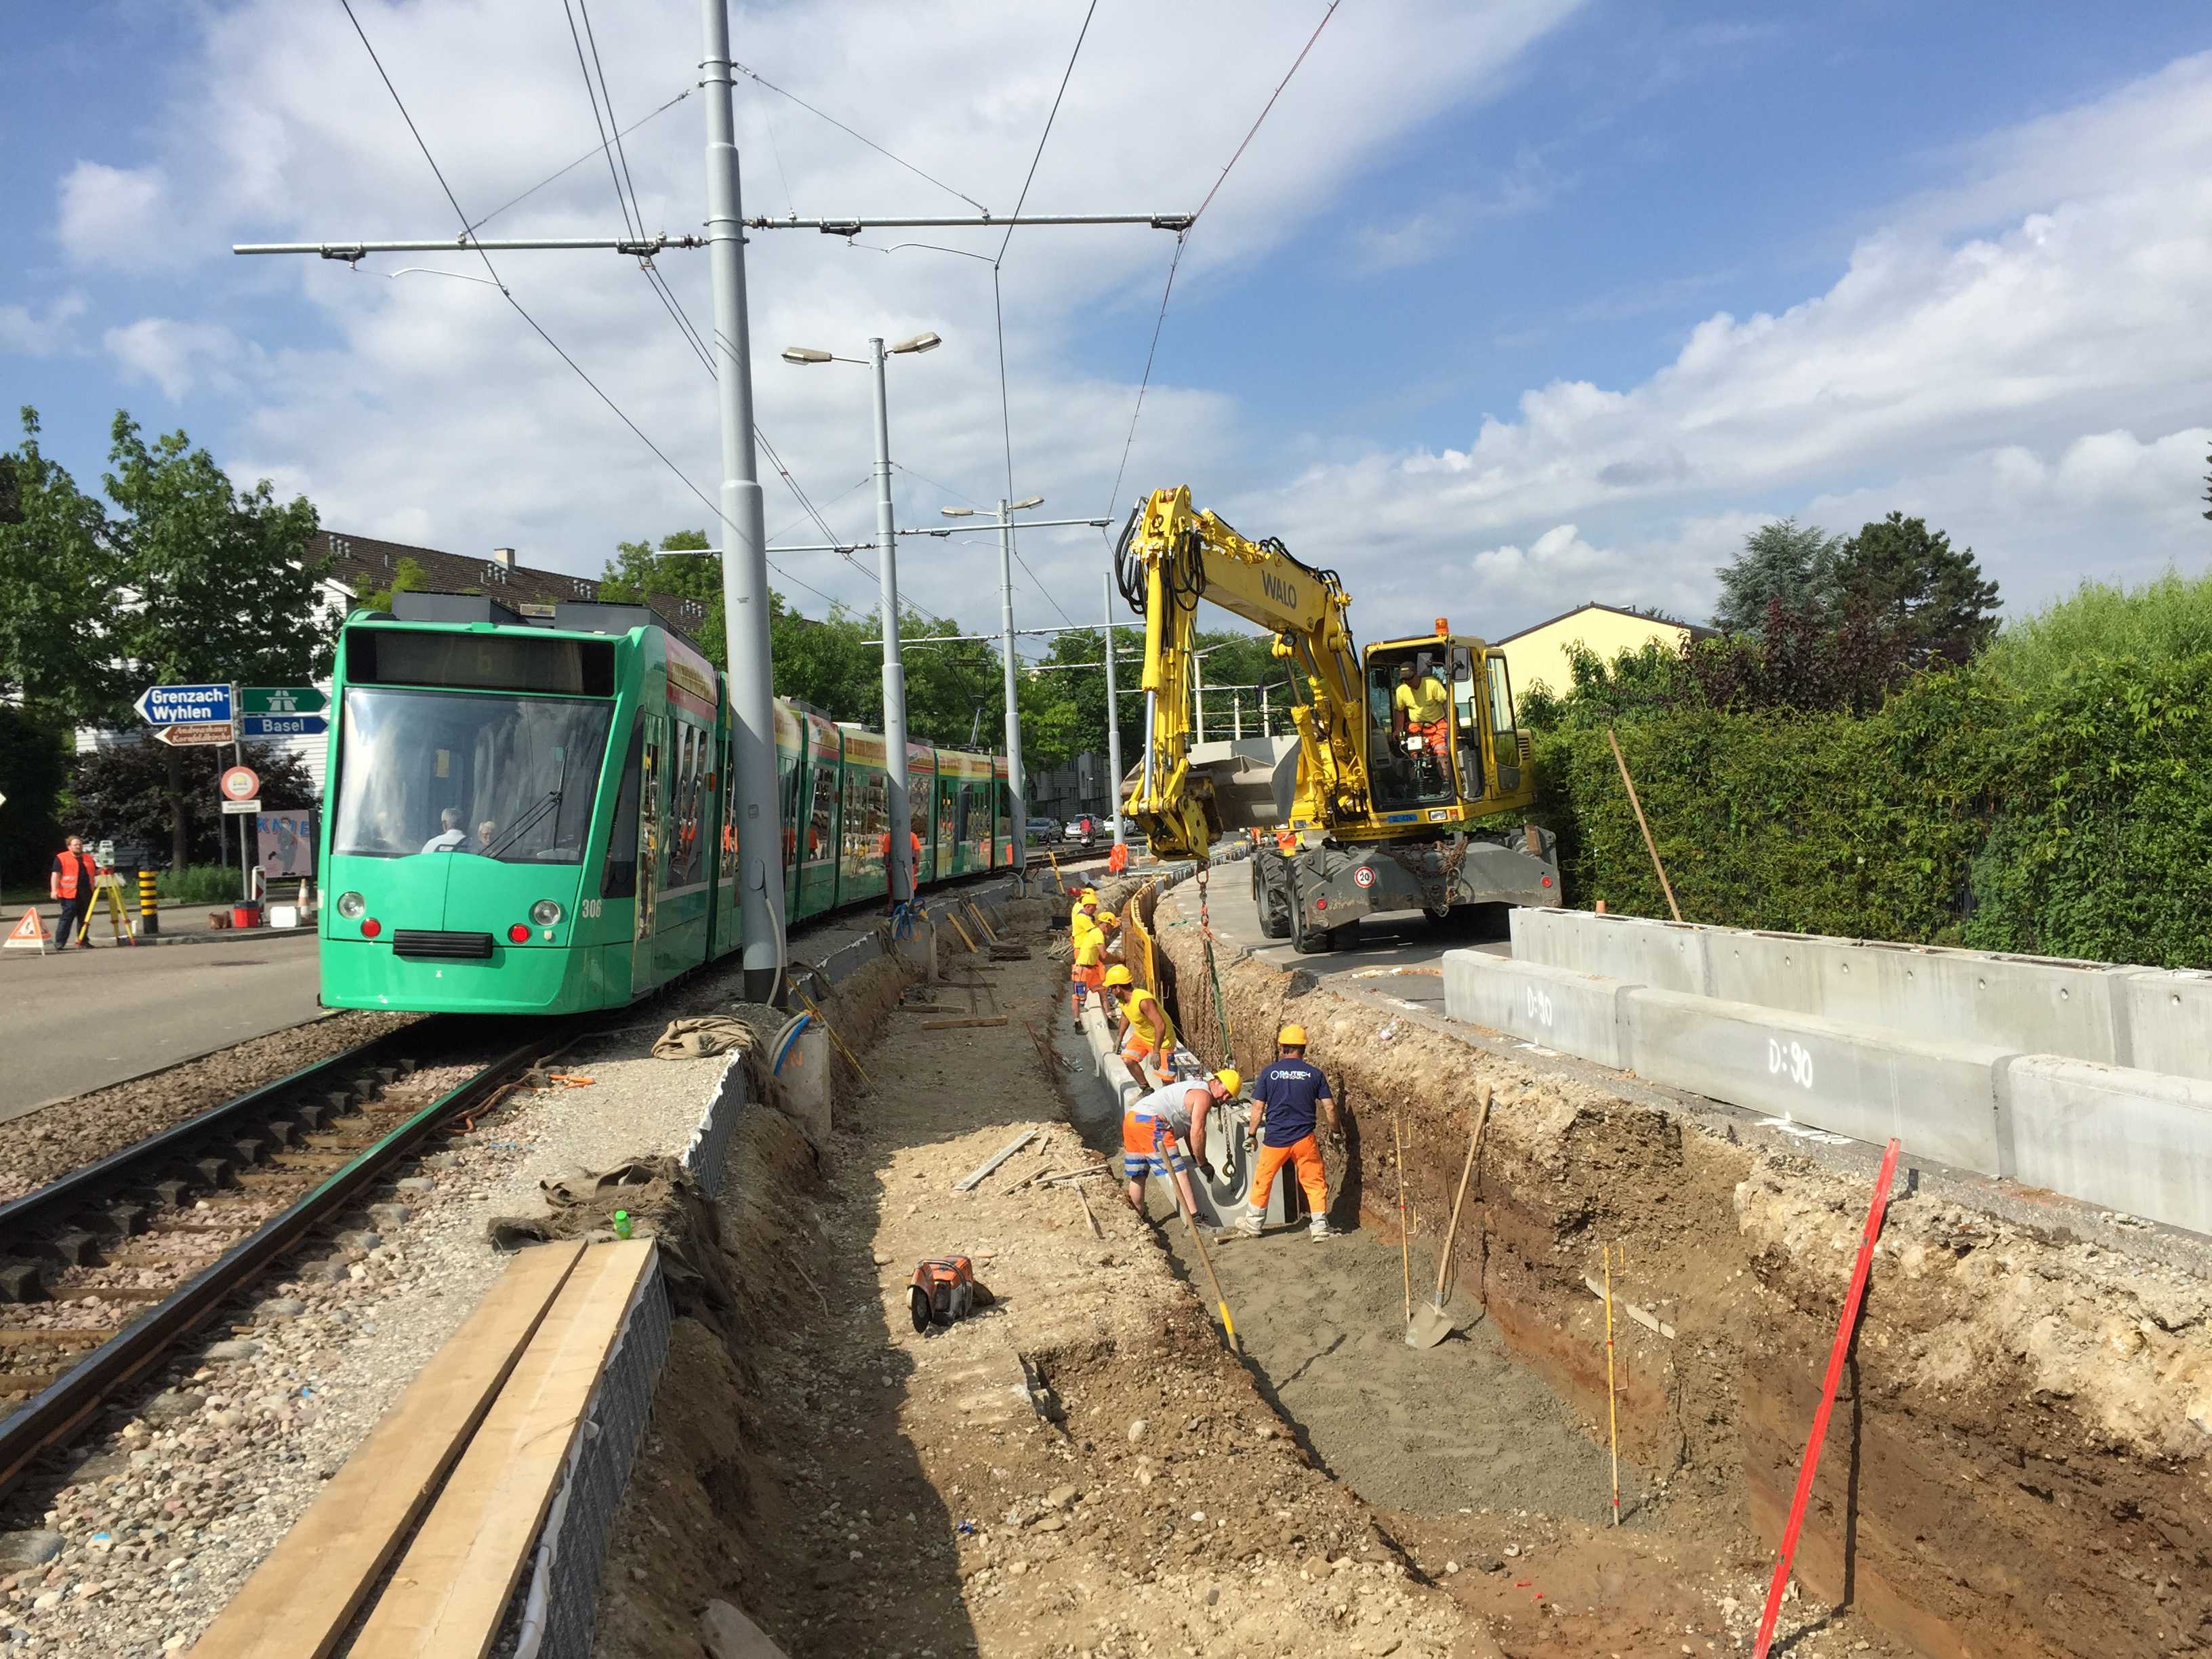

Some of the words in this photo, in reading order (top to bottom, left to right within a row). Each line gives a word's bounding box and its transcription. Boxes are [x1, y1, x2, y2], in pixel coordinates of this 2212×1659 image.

[1261, 569, 1297, 610] WALO
[151, 689, 229, 704] Grenzach-
[152, 706, 211, 722] Wyhlen
[262, 718, 304, 732] Basel
[1359, 872, 1370, 881] 20
[582, 899, 602, 918] 306
[1769, 1038, 1814, 1088] D:90
